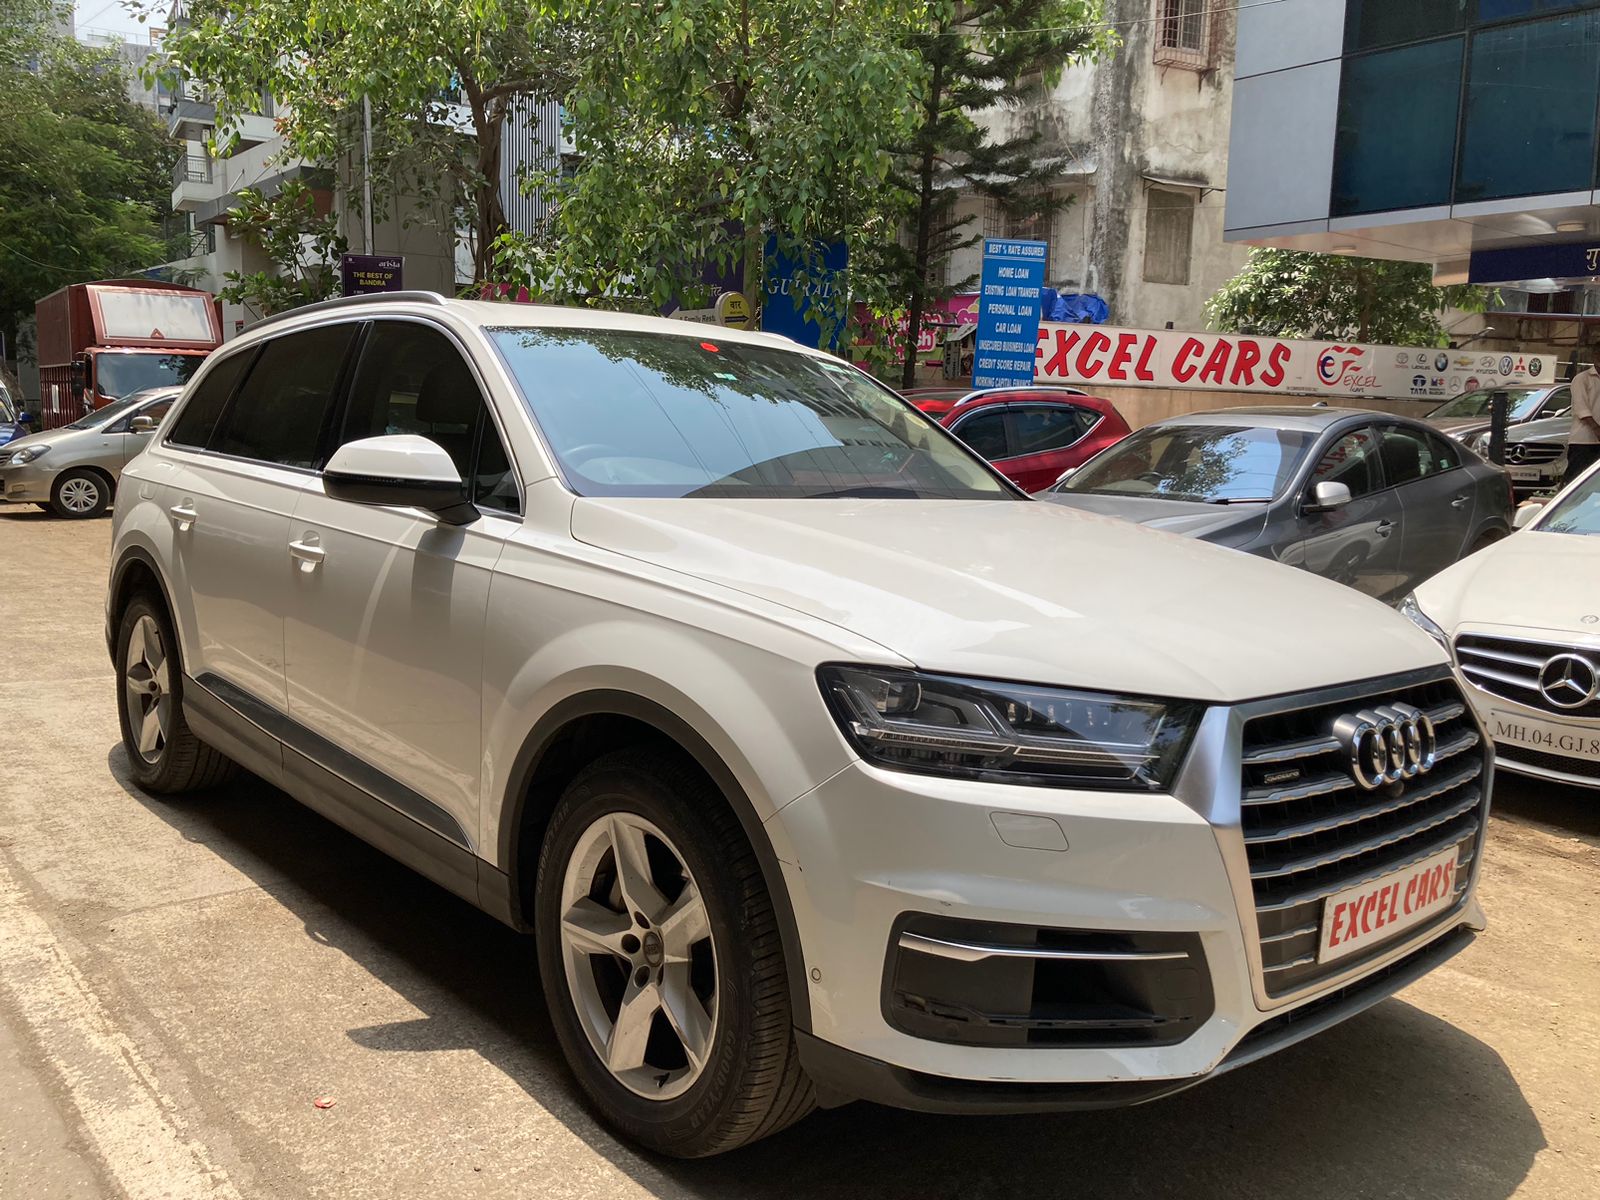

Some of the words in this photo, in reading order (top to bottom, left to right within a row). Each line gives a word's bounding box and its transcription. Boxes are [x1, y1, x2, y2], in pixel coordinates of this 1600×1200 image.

[988, 244, 1002, 254] BEST
[1007, 245, 1021, 255] RATE
[1021, 246, 1044, 256] ASSURED
[353, 271, 366, 279] THE
[998, 267, 1014, 278] HOME
[1014, 268, 1030, 279] LOAN
[359, 279, 386, 287] BANDRA
[984, 284, 1005, 296] EXISTING
[1005, 286, 1017, 297] LOAN
[1017, 287, 1040, 298] TRANSFER
[988, 303, 1015, 315] PERSONAL
[1017, 305, 1033, 316] LOAN
[995, 322, 1006, 333] CAR
[1007, 323, 1022, 334] LOAN
[978, 340, 1002, 351] UNSECURED
[1002, 341, 1023, 352] BUSINESS
[1023, 342, 1035, 353] LOAN
[978, 358, 996, 369] CREDIT
[996, 359, 1013, 370] SCORE
[1013, 360, 1031, 371] REPAIR
[1171, 336, 1292, 387] CARS
[995, 377, 1012, 388] CAPITAL
[1343, 374, 1382, 389] EXCEL
[1328, 881, 1400, 948] EXCEL
[1403, 857, 1455, 916] CARS
